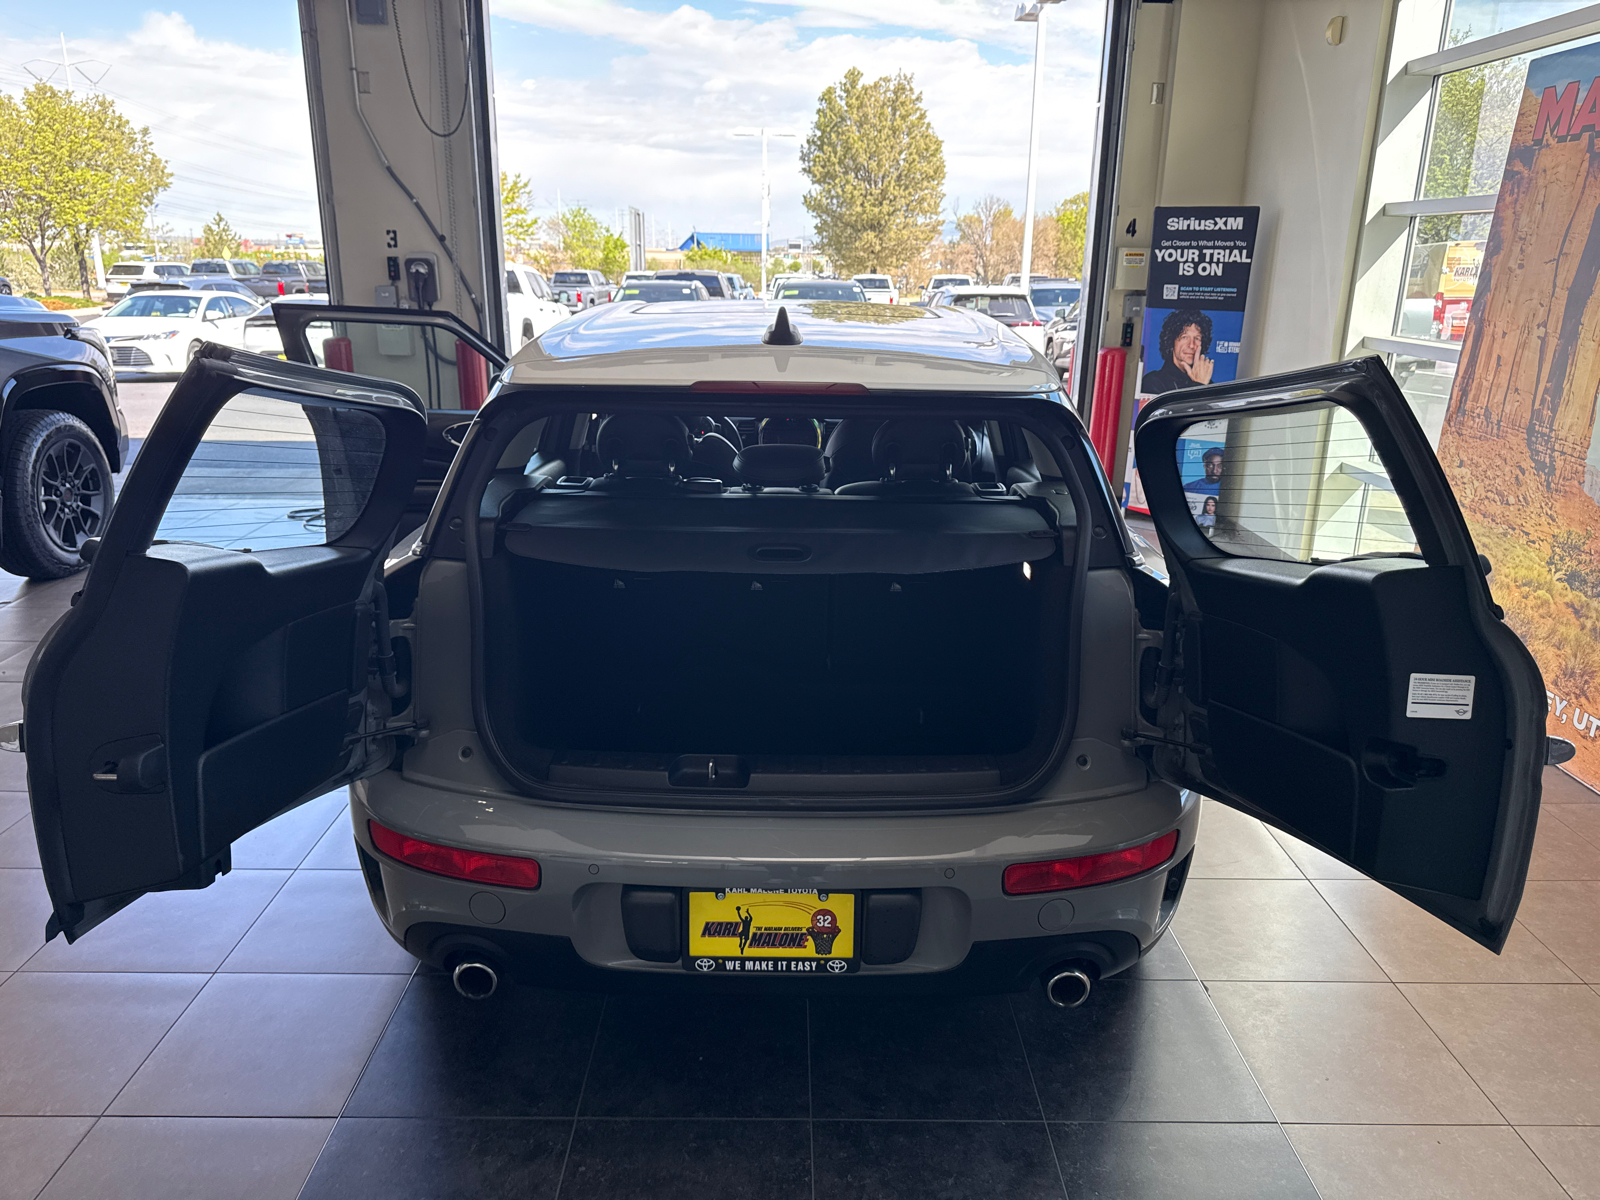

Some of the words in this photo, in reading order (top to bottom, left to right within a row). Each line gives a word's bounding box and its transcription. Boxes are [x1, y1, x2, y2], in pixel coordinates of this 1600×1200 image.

[1125, 218, 1137, 238] 4
[1166, 216, 1244, 230] SiriusXM
[386, 230, 398, 248] 3
[1154, 248, 1199, 262] YOUR
[1202, 249, 1251, 263] TRIAL
[1178, 263, 1194, 276] IS
[1197, 263, 1223, 276] ON
[1573, 707, 1600, 738] UT
[816, 915, 832, 927] 32
[701, 921, 741, 938] KARL
[748, 932, 808, 948] MALONE
[726, 961, 741, 970] WE
[745, 961, 774, 971] MAKE
[778, 961, 787, 971] IT
[791, 961, 817, 971] EASY
